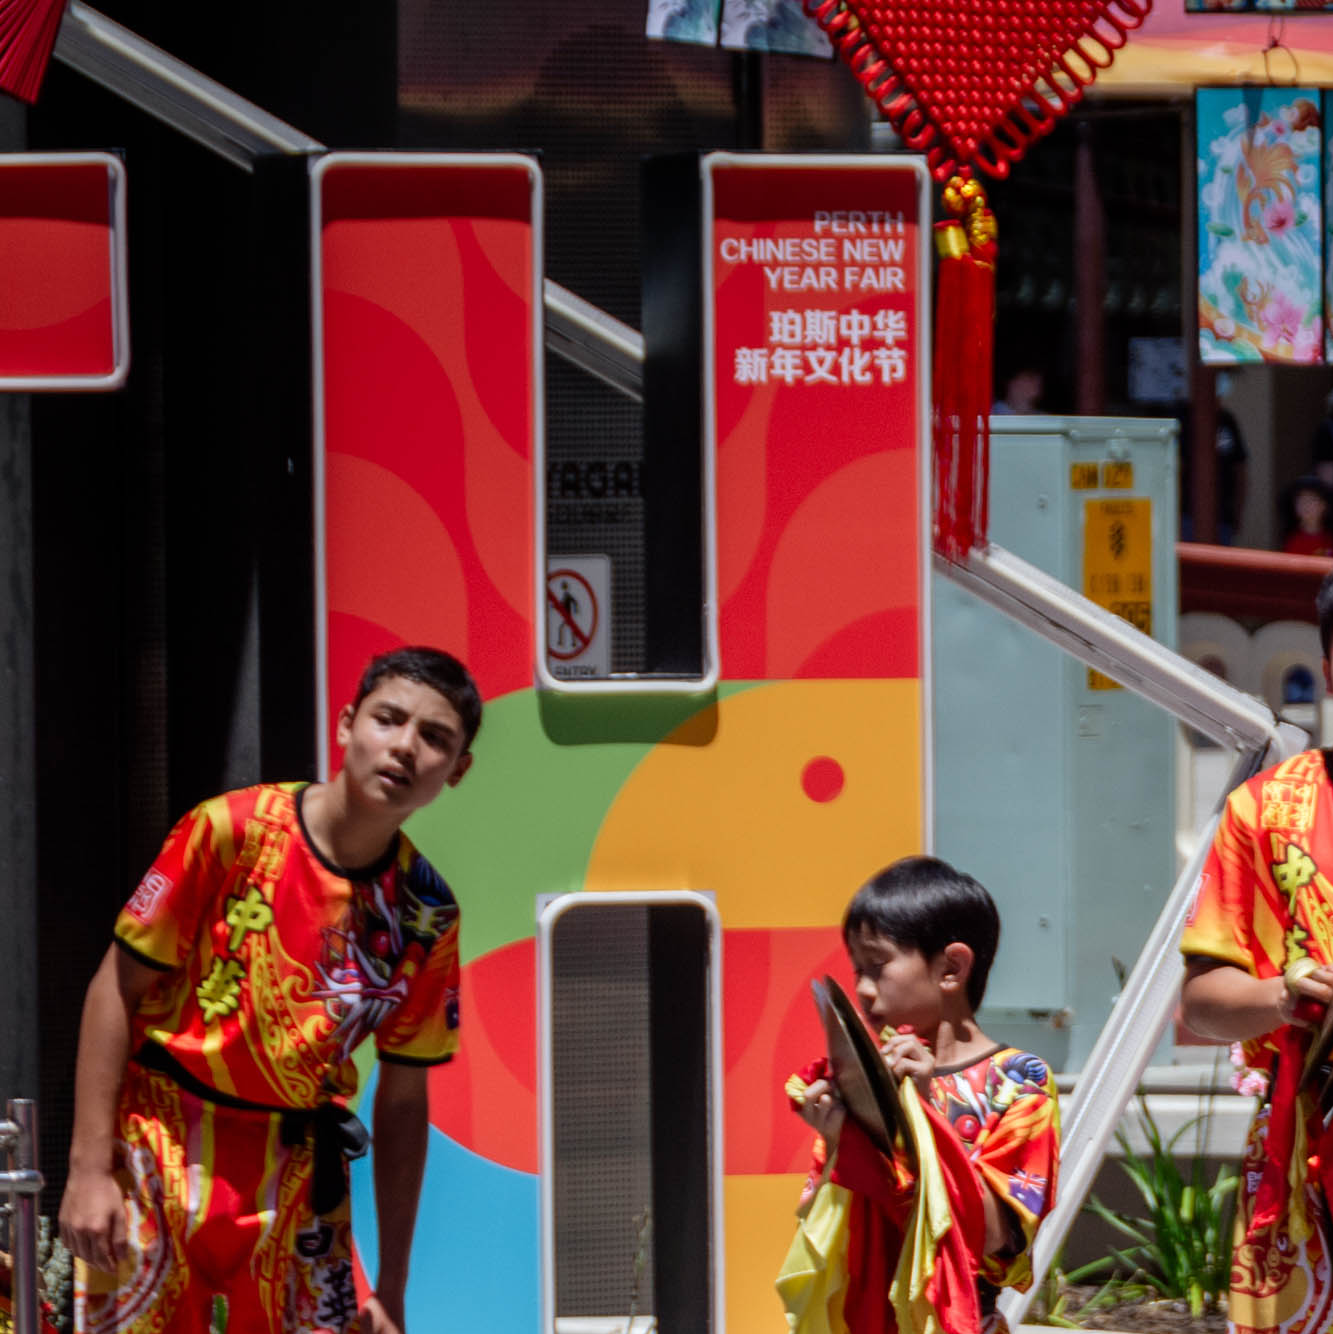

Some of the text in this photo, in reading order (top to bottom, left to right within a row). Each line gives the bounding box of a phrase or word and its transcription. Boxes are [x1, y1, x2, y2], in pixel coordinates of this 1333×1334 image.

[813, 210, 904, 233] PERTH
[720, 238, 905, 262] CHINESE NEW
[764, 266, 905, 290] YEAR FAIR
[769, 309, 906, 345] 珀斯中华
[734, 347, 907, 383] 新年文化节
[548, 462, 646, 497] AGA
